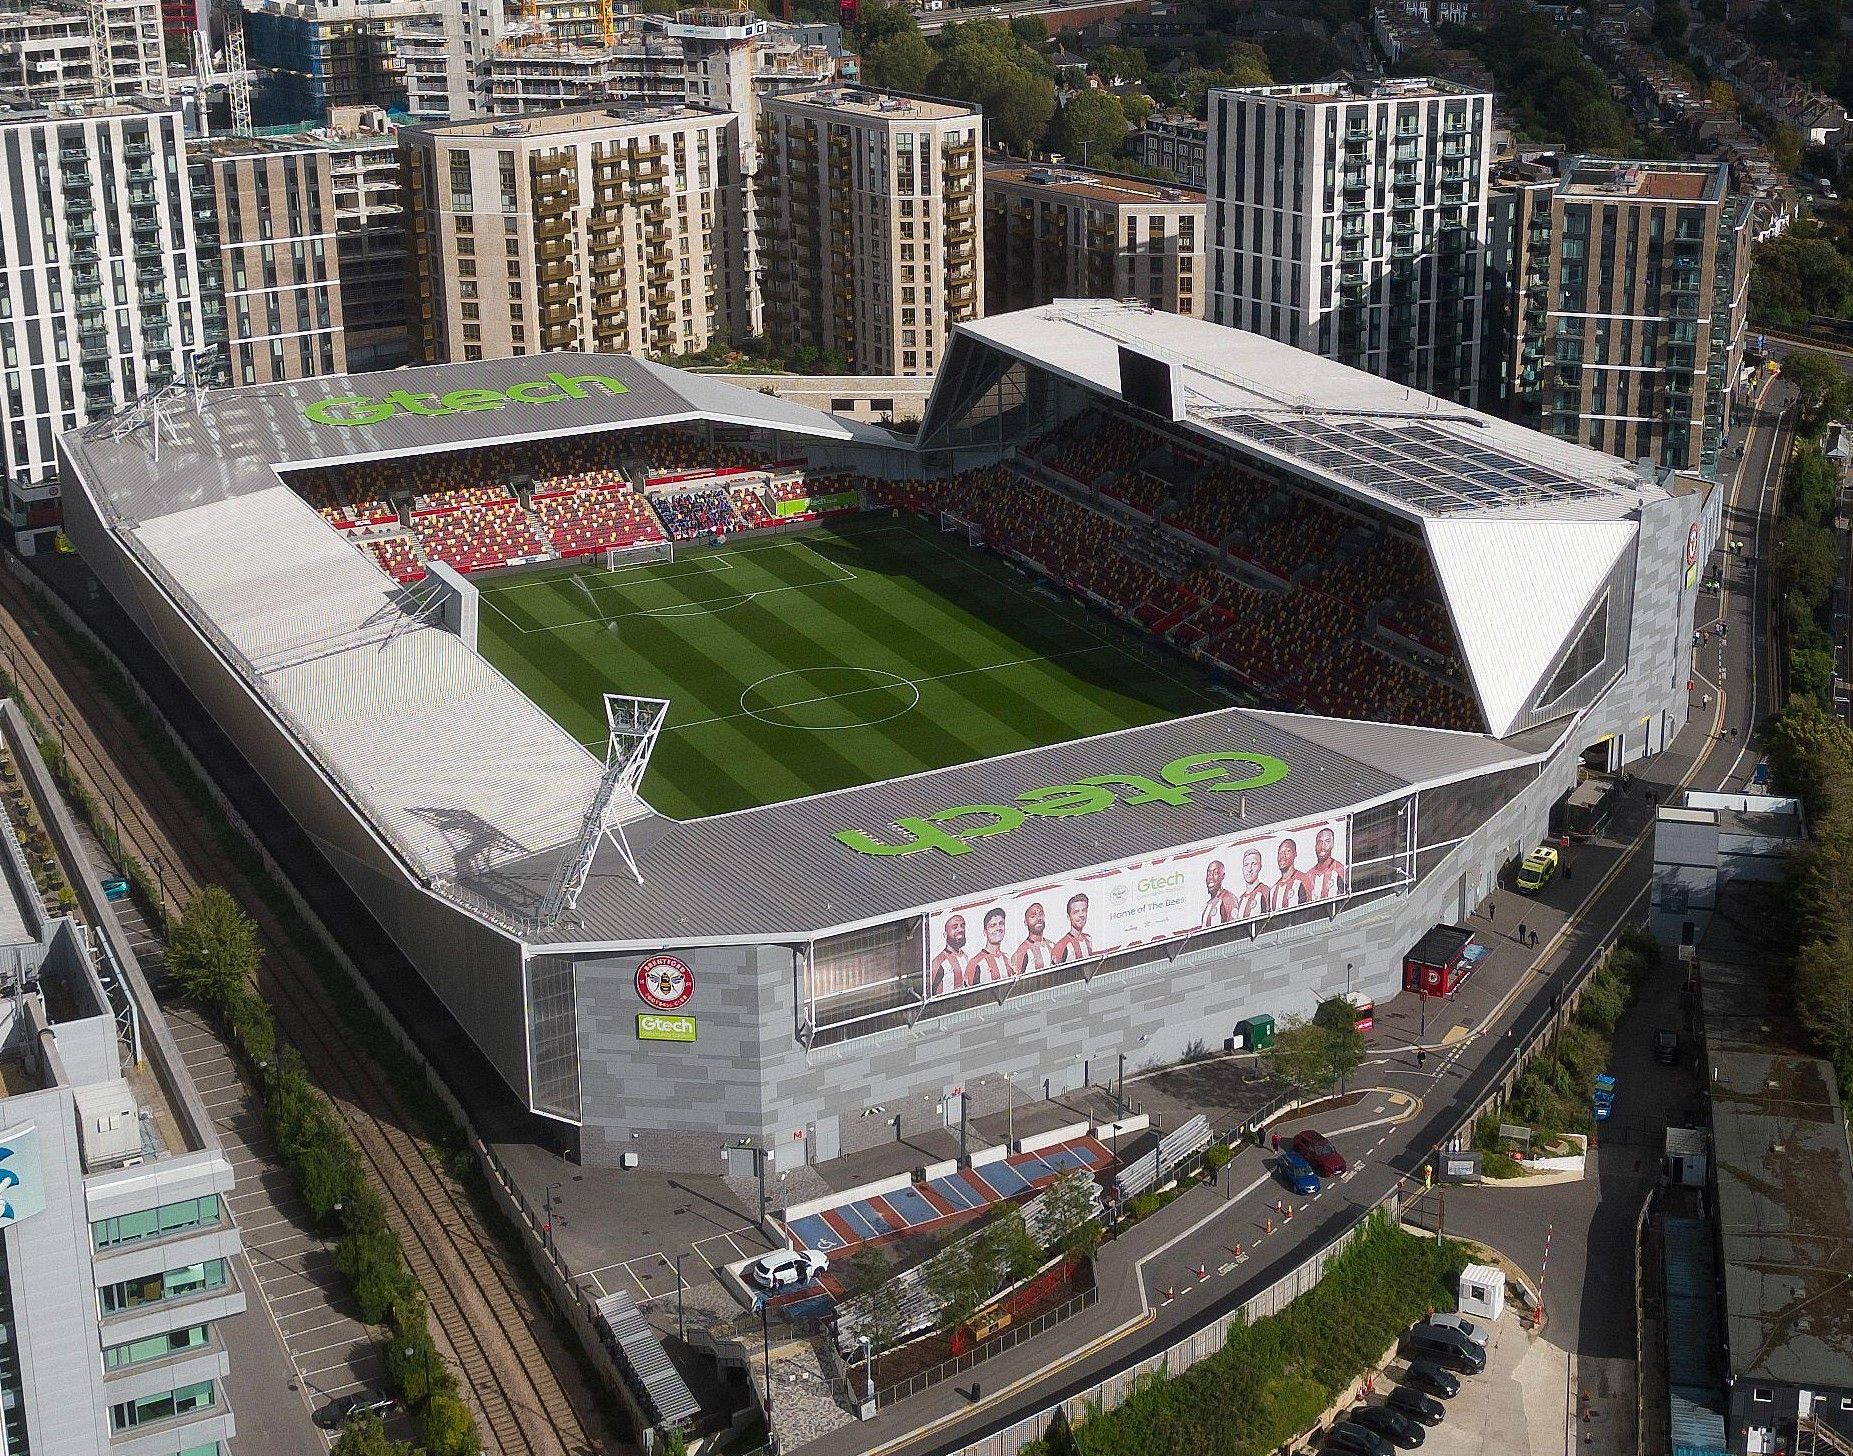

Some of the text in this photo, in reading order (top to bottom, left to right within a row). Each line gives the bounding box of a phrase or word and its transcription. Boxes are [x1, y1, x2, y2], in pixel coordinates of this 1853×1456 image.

[304, 373, 630, 426] Gtech
[833, 752, 1290, 856] Gtech
[1138, 871, 1185, 893] Gtech
[1110, 907, 1136, 921] Home
[1137, 904, 1146, 914] of
[1147, 901, 1163, 911] The
[644, 959, 686, 973] BRENTFORD
[641, 1016, 693, 1033] Gtech
